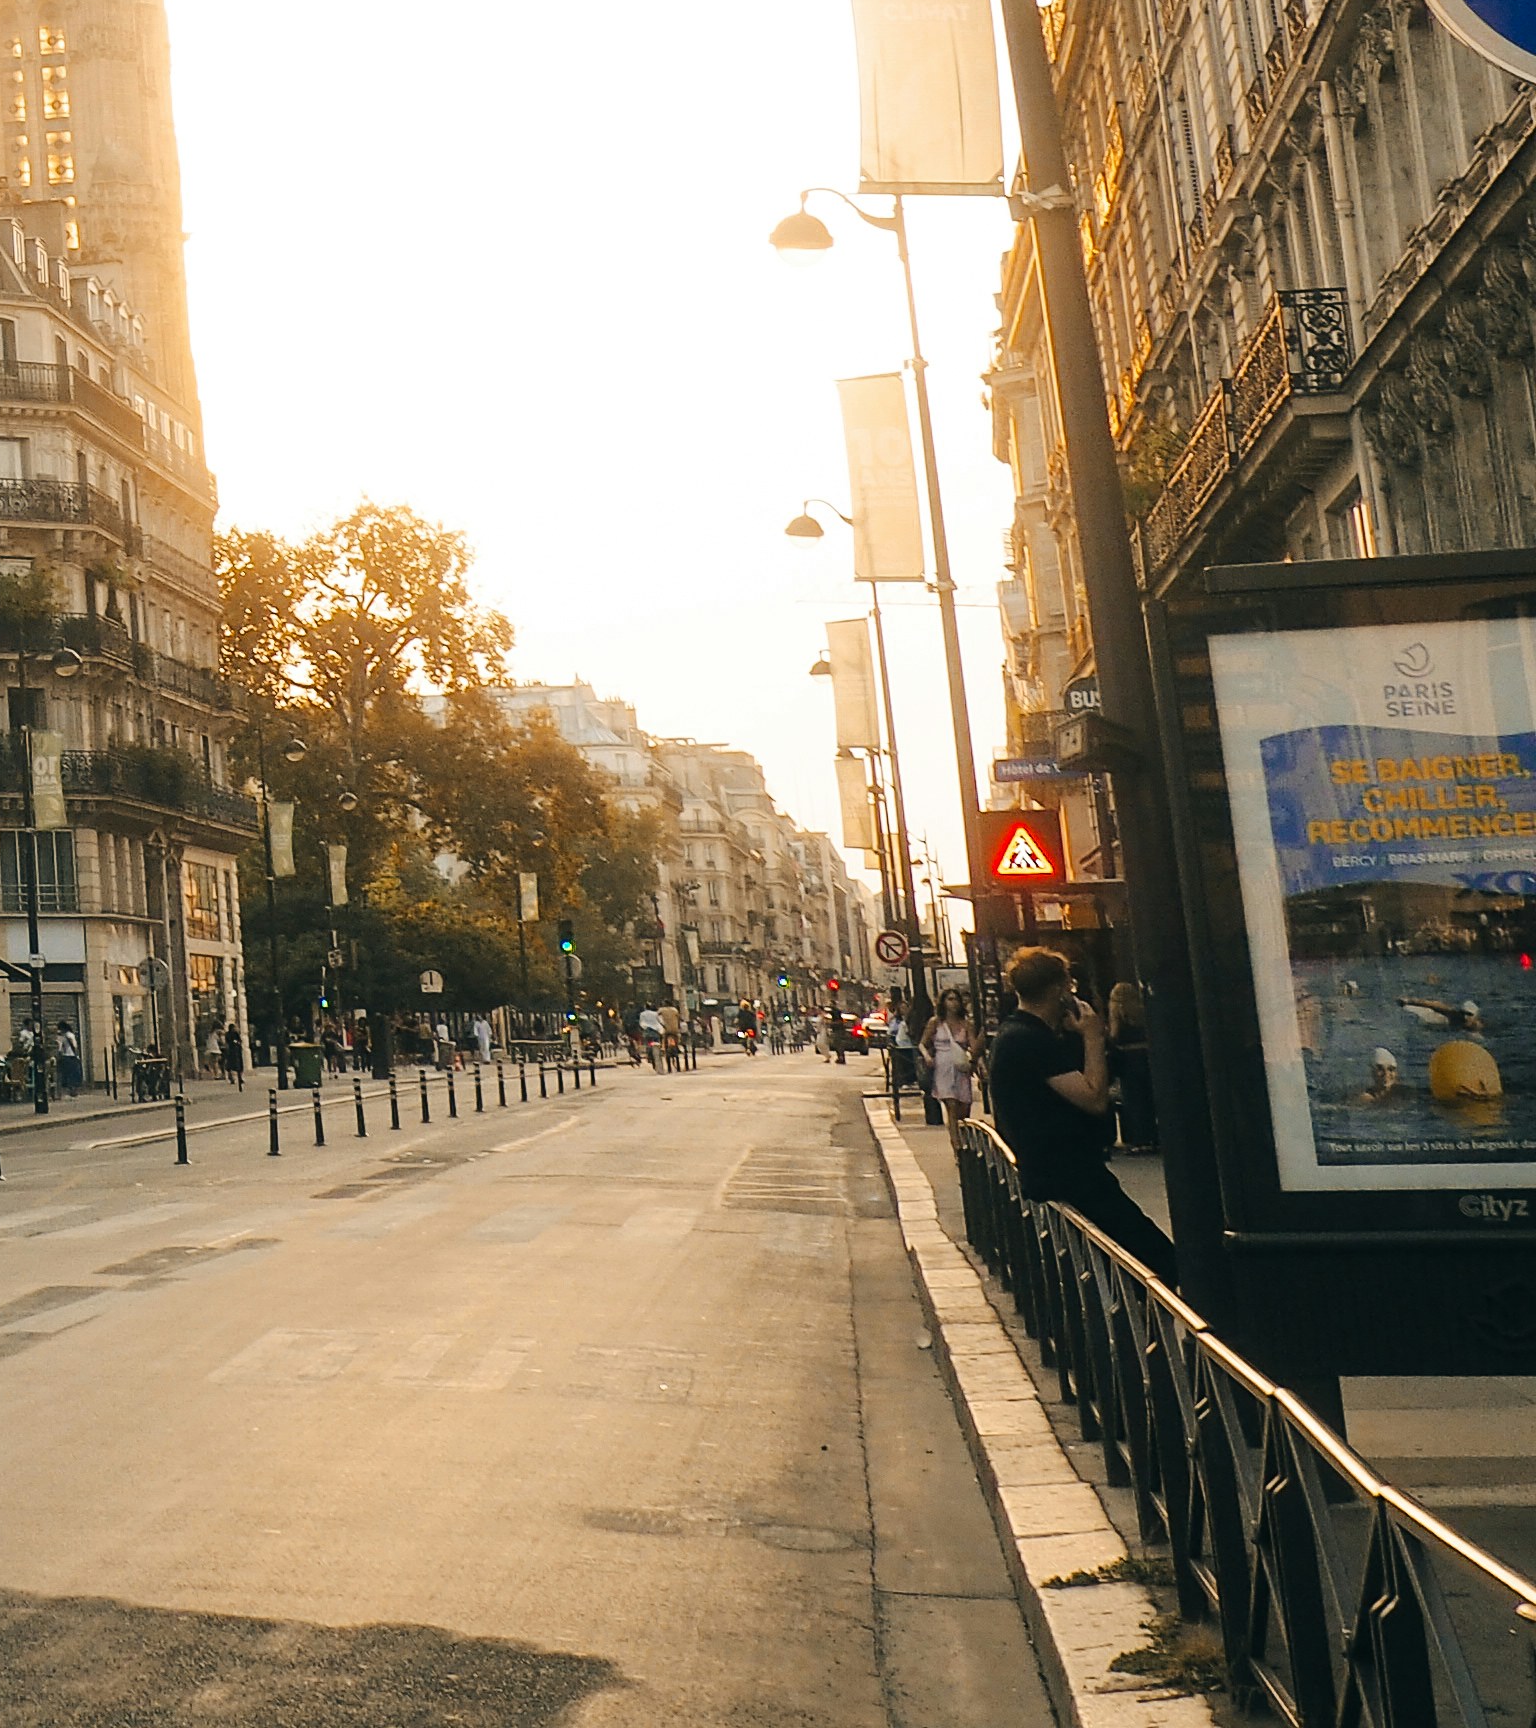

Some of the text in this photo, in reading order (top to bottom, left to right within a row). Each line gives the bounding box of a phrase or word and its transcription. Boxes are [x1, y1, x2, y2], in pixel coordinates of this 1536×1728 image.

[884, 2, 971, 22] CLIMAT
[1383, 682, 1453, 700] PARIS
[1036, 763, 1050, 774] de
[1330, 752, 1531, 785] SE BAIGNER,
[1362, 784, 1509, 814] CHILLER,
[1308, 812, 1536, 845] RECOMMENCE
[1332, 855, 1377, 868] BERCY
[1387, 852, 1426, 866] BRAS
[1458, 1194, 1528, 1222] Cityz
